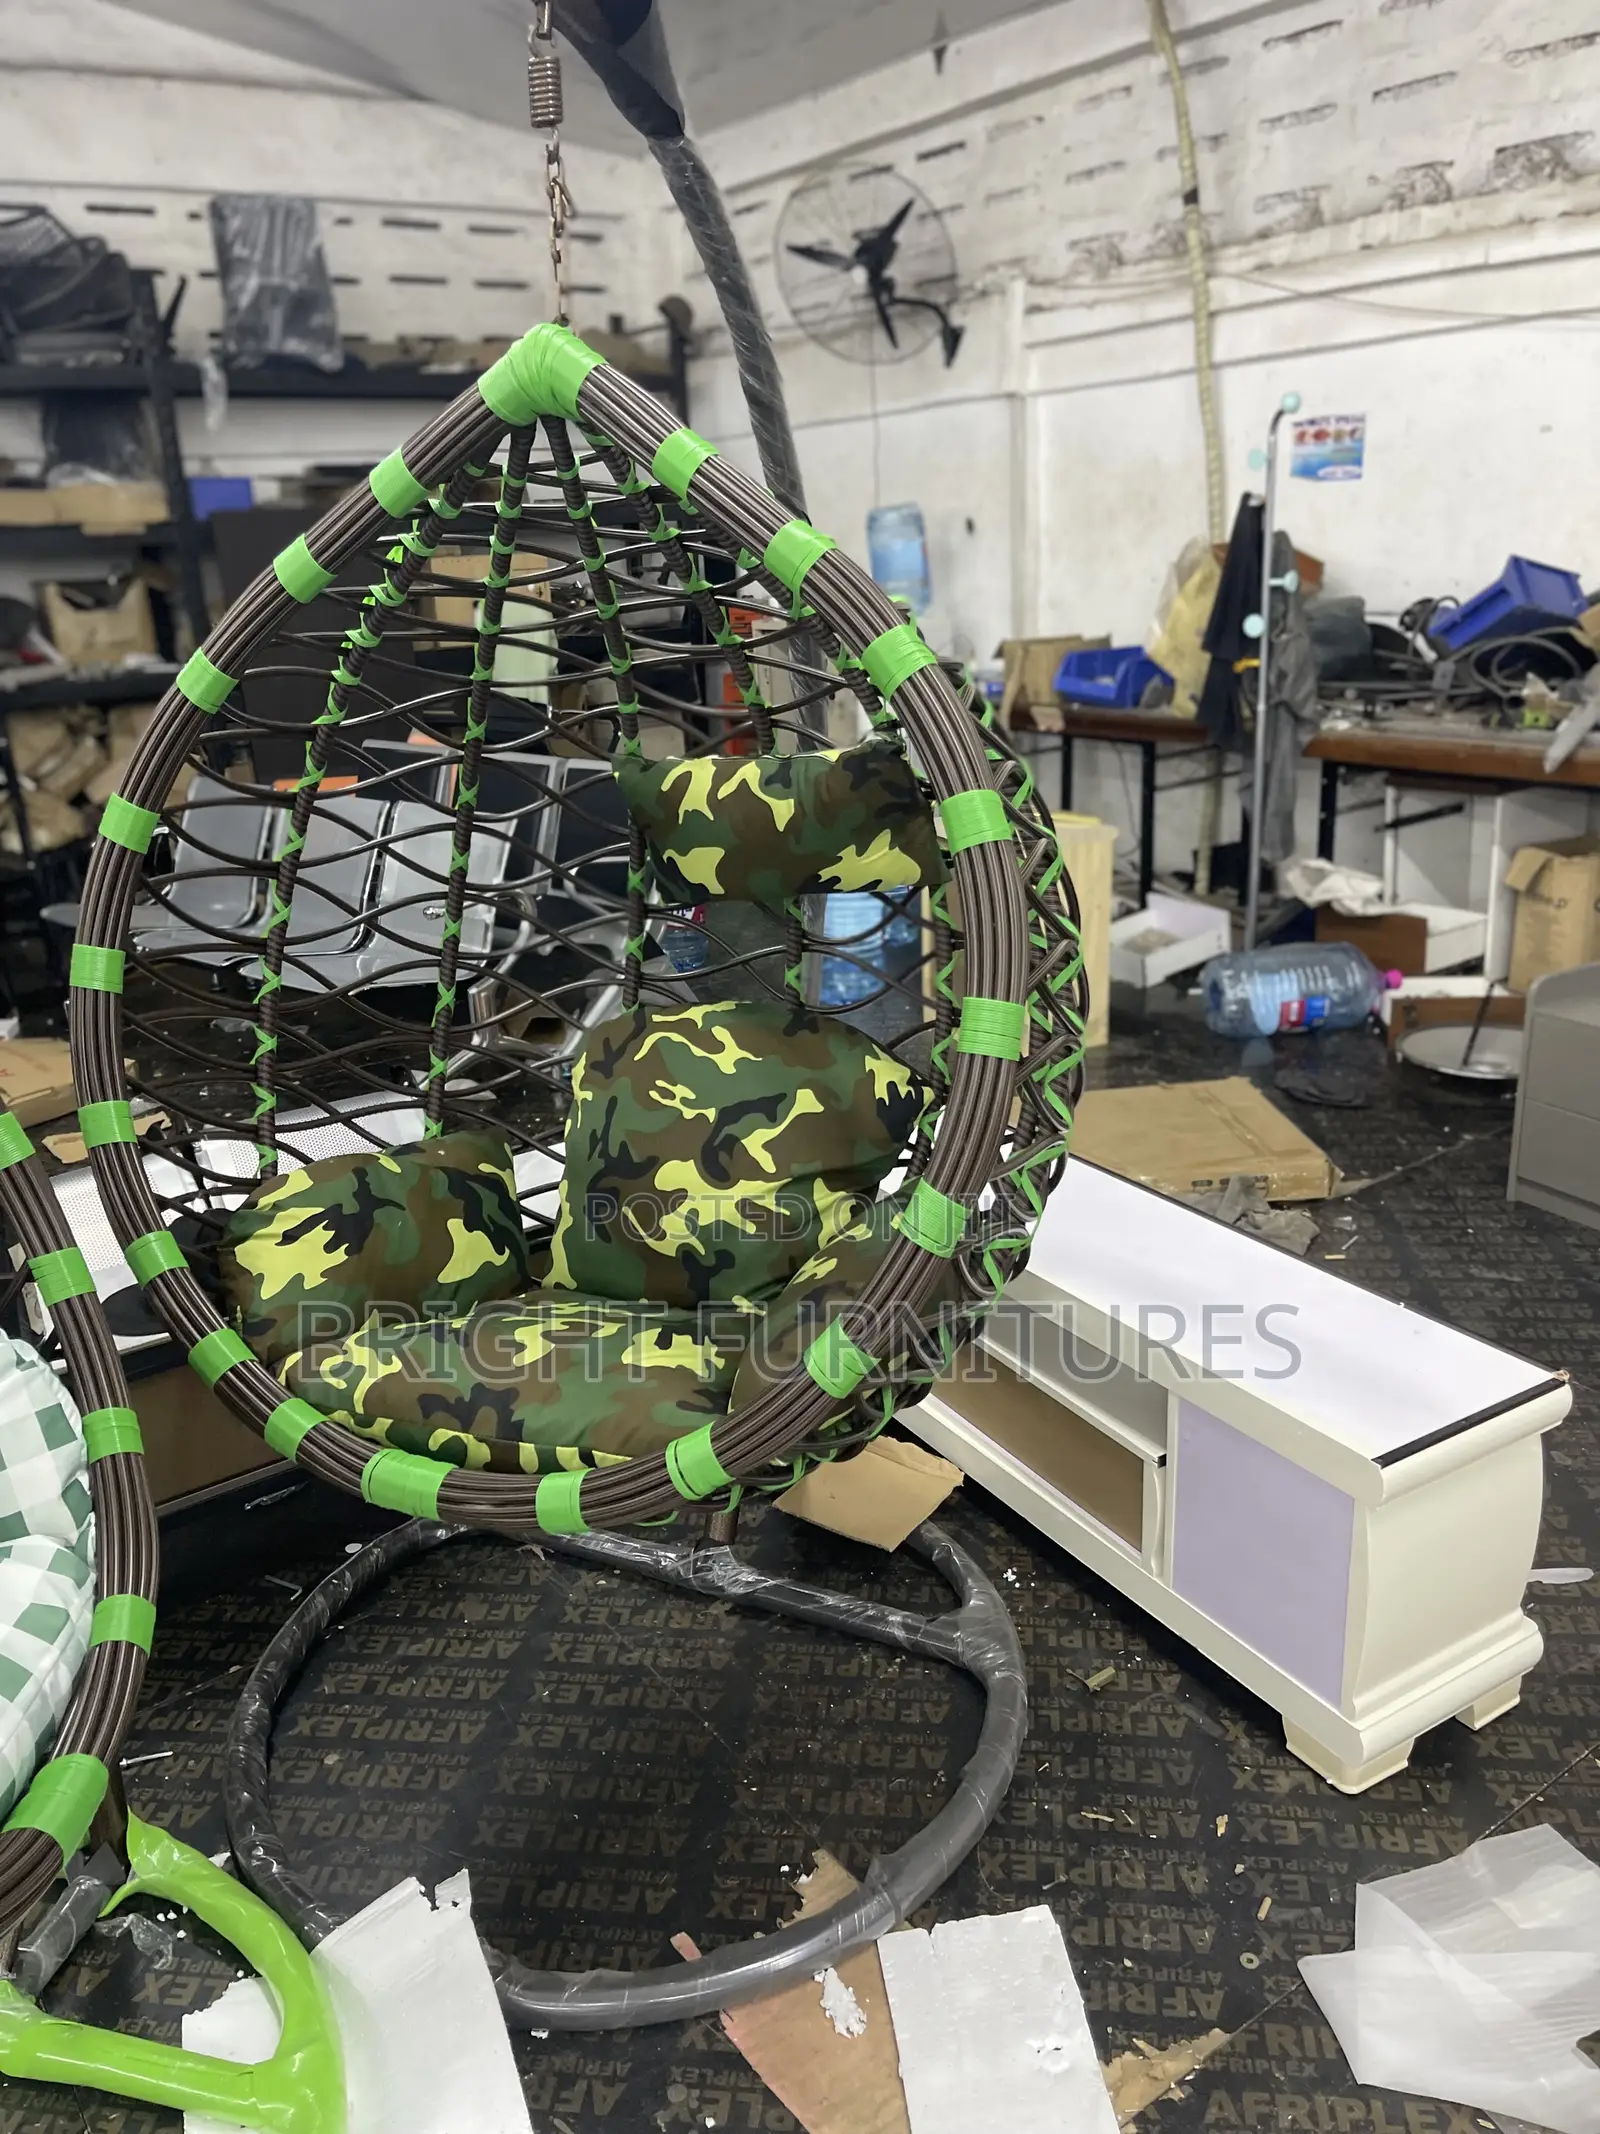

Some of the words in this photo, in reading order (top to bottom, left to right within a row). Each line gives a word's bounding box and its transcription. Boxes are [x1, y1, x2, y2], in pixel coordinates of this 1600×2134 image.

[338, 1635, 523, 1659] AFRIPLEX
[544, 1642, 732, 1670] AFRIPLEX
[325, 1662, 410, 1674] AFRIPLEX
[312, 1674, 507, 1700] AFRIPLEX
[528, 1682, 724, 1711] AFRIPLEX
[134, 1711, 235, 1733] FRIPL
[405, 1707, 493, 1720] AFRIPLEX
[1028, 1710, 1189, 1738] AFRIPL
[287, 1716, 486, 1744] AFRIPLEX
[508, 1725, 713, 1756] AFRIPLEX
[164, 1743, 230, 1754] RIPLEX
[382, 1751, 471, 1766] AFRIPLEX
[1226, 1753, 1301, 1768] RIPLEX
[270, 1760, 467, 1790] AFRIPLEX
[1018, 1756, 1194, 1786] AFRIPLE
[490, 1771, 700, 1803] AFRIPLEX
[272, 1796, 339, 1809] AFRIPL
[1232, 1802, 1337, 1820] AFRIPLEX
[1360, 1810, 1464, 1829] AFRIPLEX
[270, 1809, 446, 1842] AFRIPLE
[471, 1819, 689, 1857] AFRIPLEX
[1235, 1816, 1469, 1856] AFRIPLEX
[980, 1851, 1210, 1895] AFRIPLEX
[471, 1876, 678, 1914] AFRIPLE
[1058, 1915, 1217, 1954] AFRIP
[117, 2018, 182, 2035] IPLEX
[1203, 2089, 1484, 2134] AFRIPLEX
